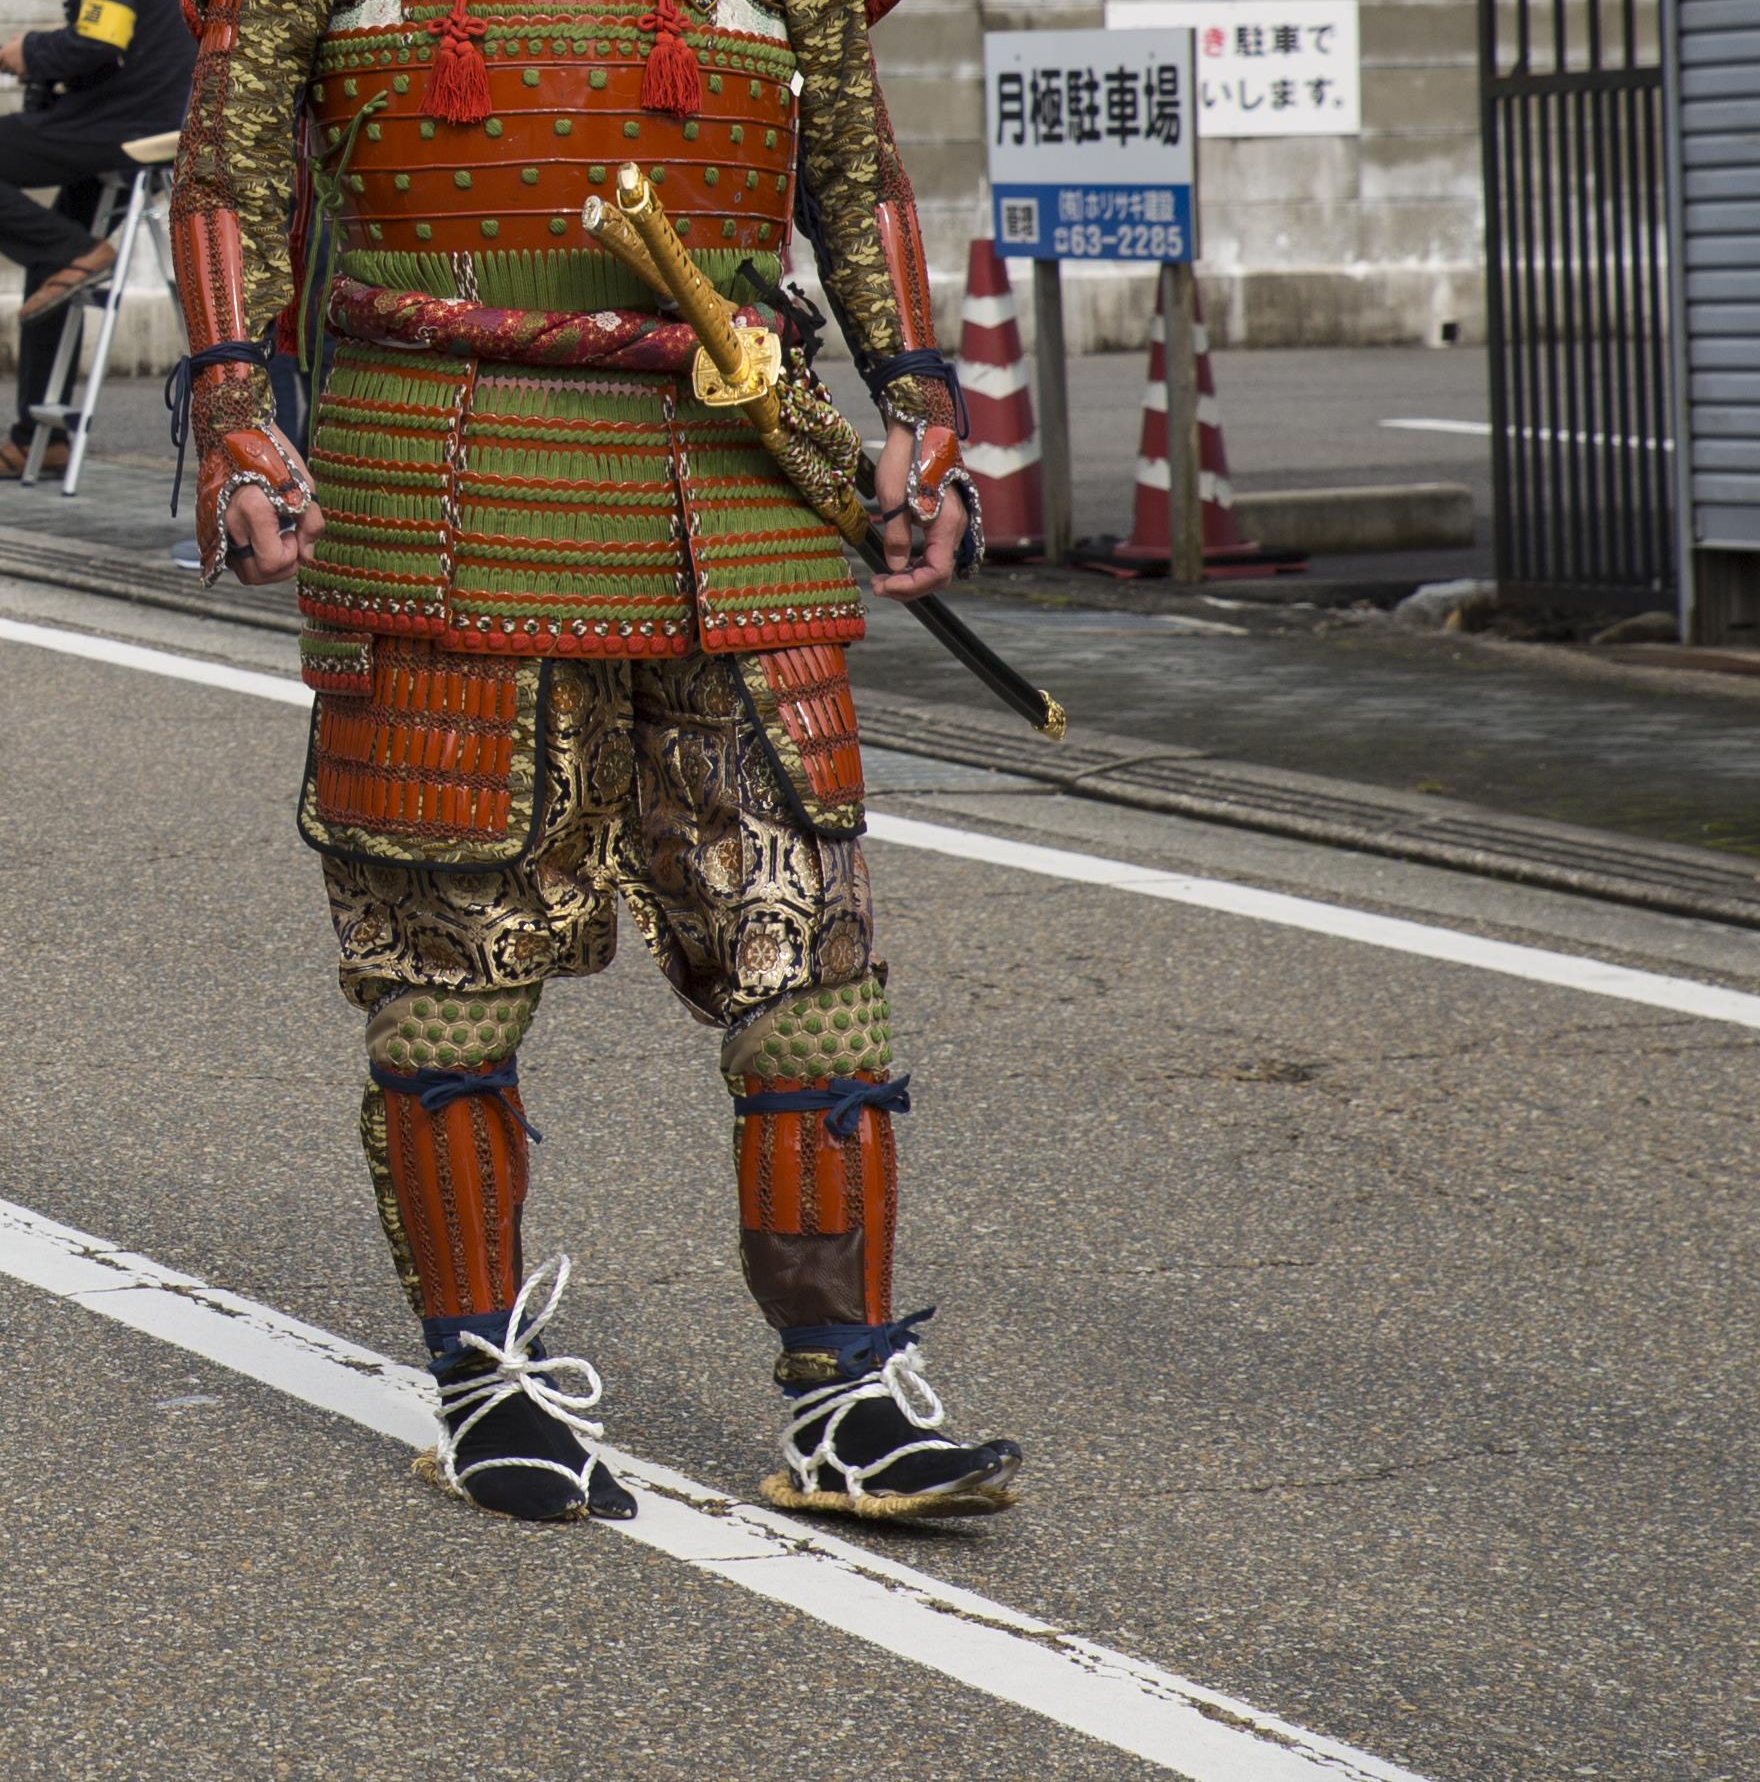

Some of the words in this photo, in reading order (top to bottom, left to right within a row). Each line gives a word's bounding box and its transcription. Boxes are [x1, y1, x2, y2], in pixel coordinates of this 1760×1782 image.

[997, 65, 1180, 147] 月極駐車場
